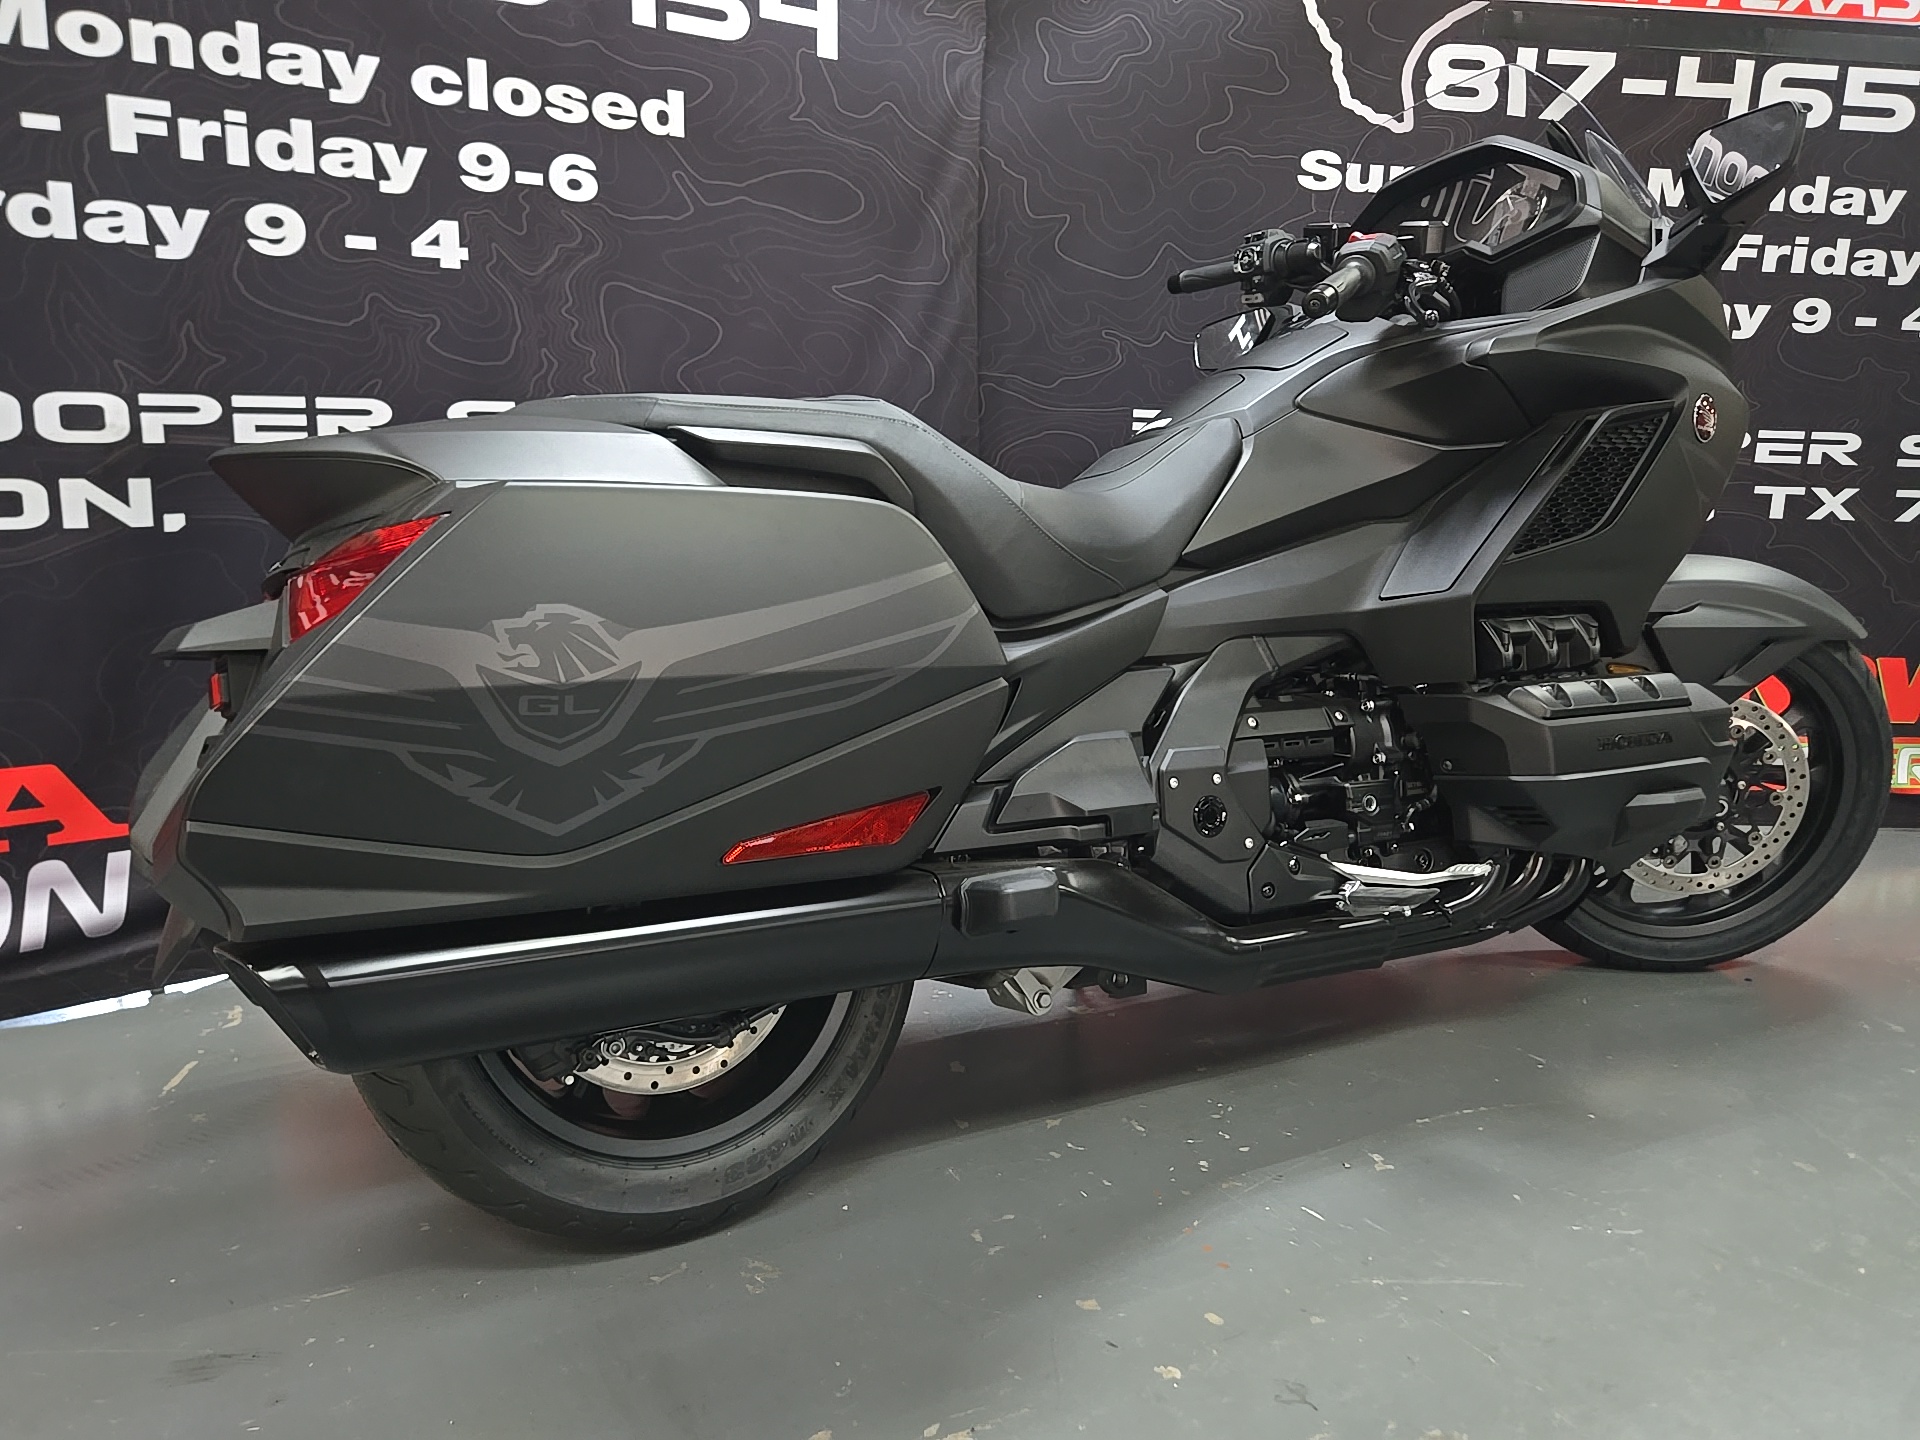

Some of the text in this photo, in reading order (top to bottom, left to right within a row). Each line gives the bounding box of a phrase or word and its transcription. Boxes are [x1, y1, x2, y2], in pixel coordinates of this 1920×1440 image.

[0, 0, 686, 139] Monday closed
[19, 93, 600, 203] - Friday 9-6
[1646, 167, 1908, 225] Mday
[0, 180, 470, 270] day 9 - 4
[1721, 233, 1920, 286] Friday
[1722, 303, 1772, 340] y
[1791, 297, 1832, 334] 9
[1854, 316, 1878, 327] -
[0, 390, 393, 444] OPER
[1740, 429, 1863, 467] ER
[1753, 485, 1861, 522] TX
[518, 694, 601, 717] GL
[0, 849, 132, 954] N
